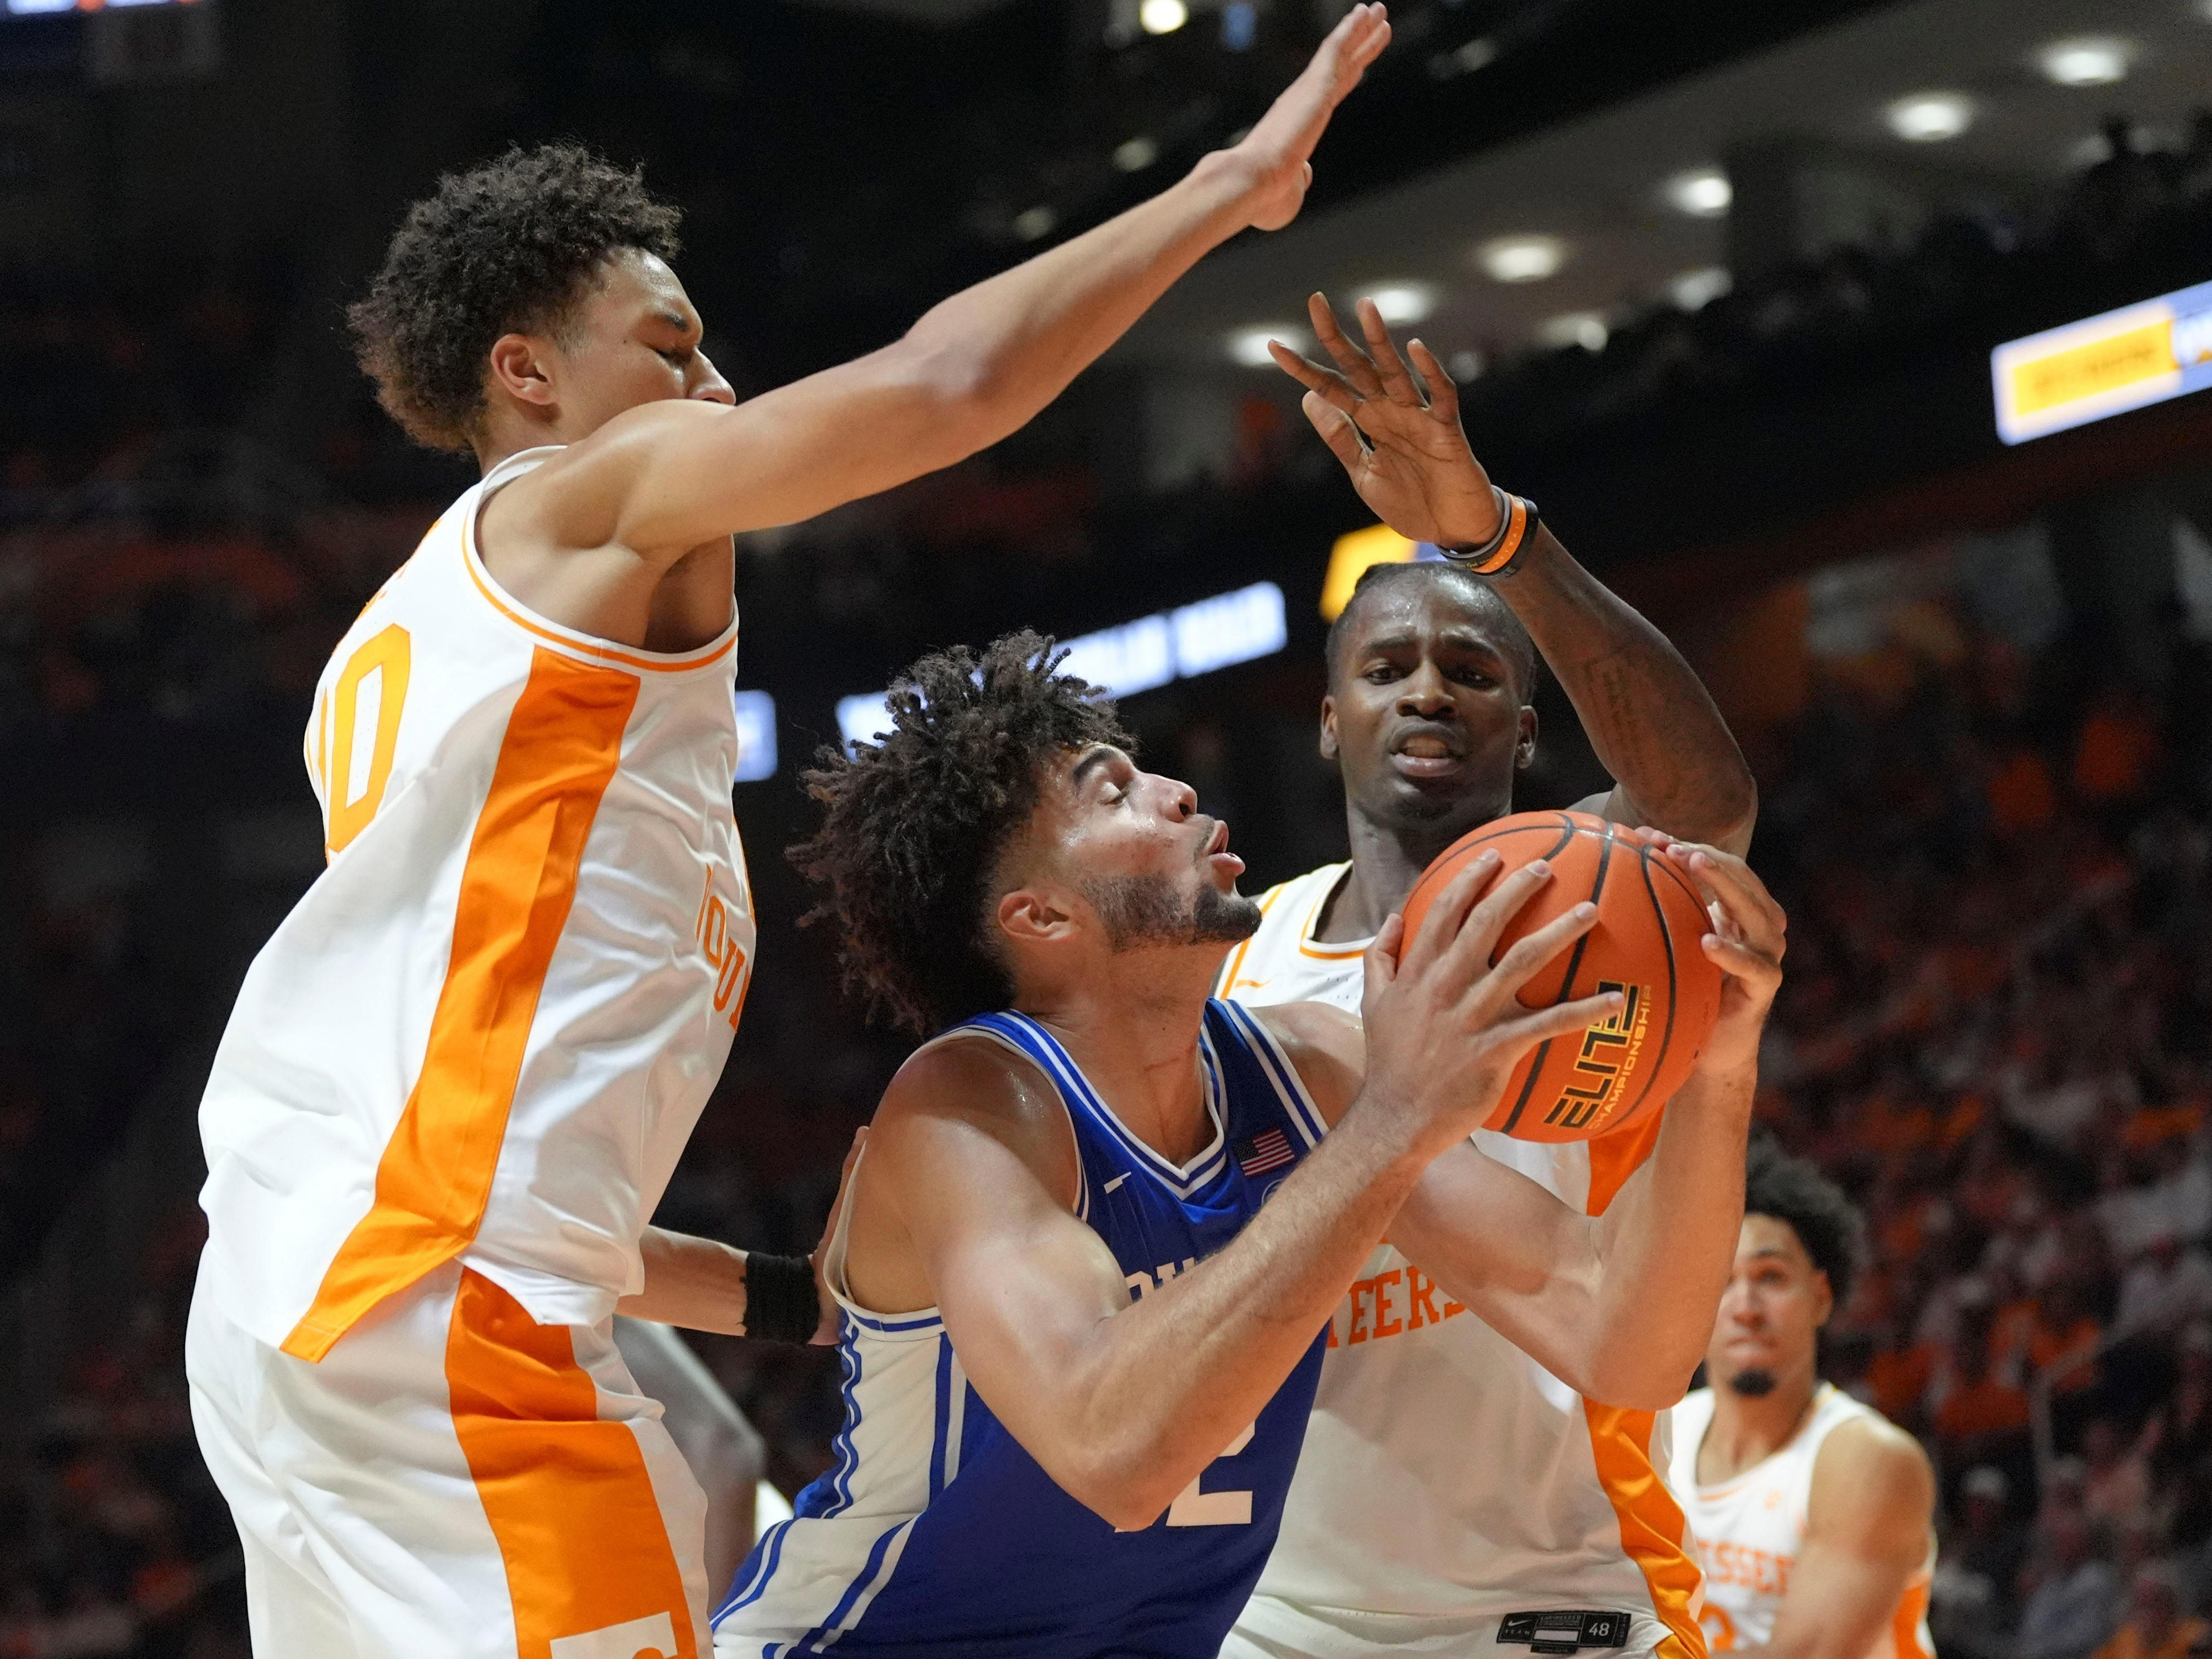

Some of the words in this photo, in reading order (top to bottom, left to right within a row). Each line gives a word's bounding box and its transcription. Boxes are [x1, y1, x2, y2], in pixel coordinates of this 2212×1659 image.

[306, 623, 411, 853] 0
[1589, 985, 1651, 1130] CHAMPIONSHIP
[1589, 1622, 1610, 1637] 48
